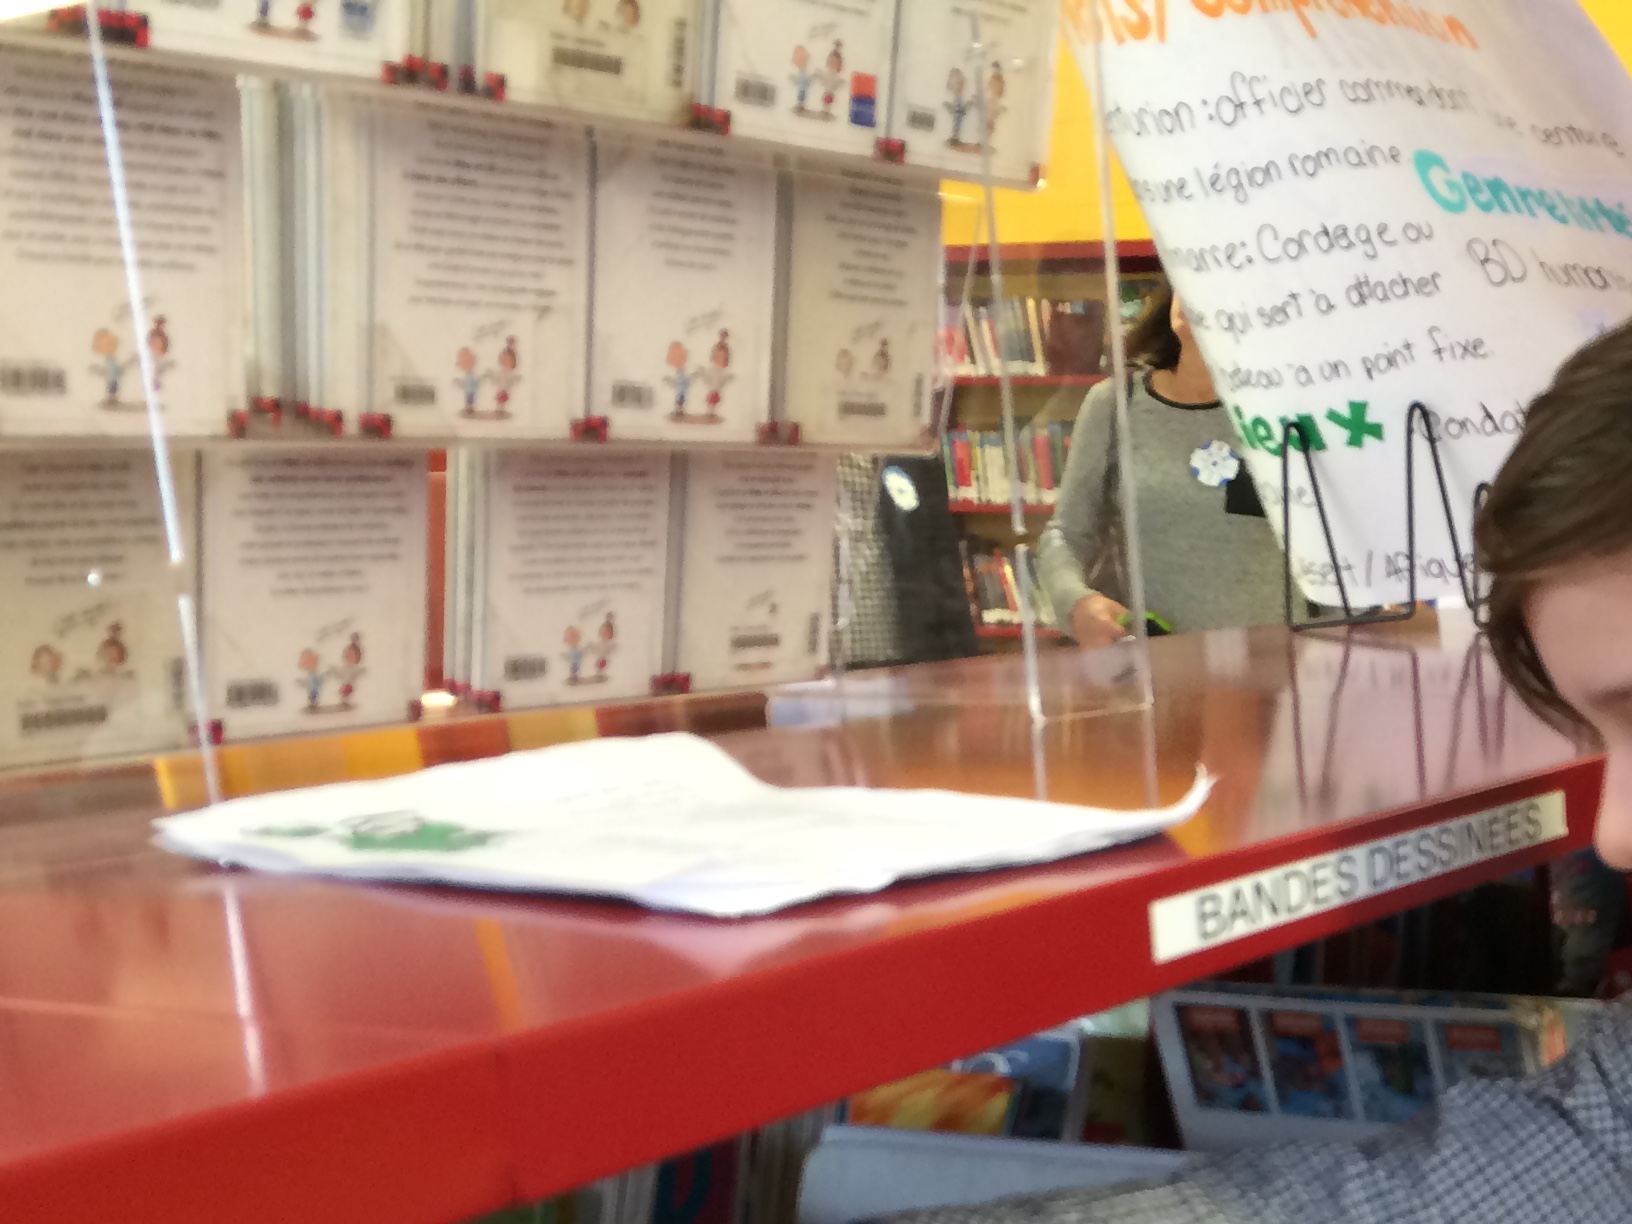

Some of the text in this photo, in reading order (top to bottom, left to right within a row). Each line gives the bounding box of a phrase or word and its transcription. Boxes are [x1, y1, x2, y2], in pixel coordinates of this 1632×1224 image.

[1193, 162, 1283, 204] légion
[1287, 140, 1402, 178] romaine
[1256, 222, 1400, 262] Cordage
[1402, 221, 1435, 244] ou
[1256, 290, 1304, 328] sert
[1345, 270, 1442, 309] attacher
[1361, 340, 1414, 381] point
[1427, 325, 1490, 361] fixe
[1195, 856, 1360, 941] BANDES
